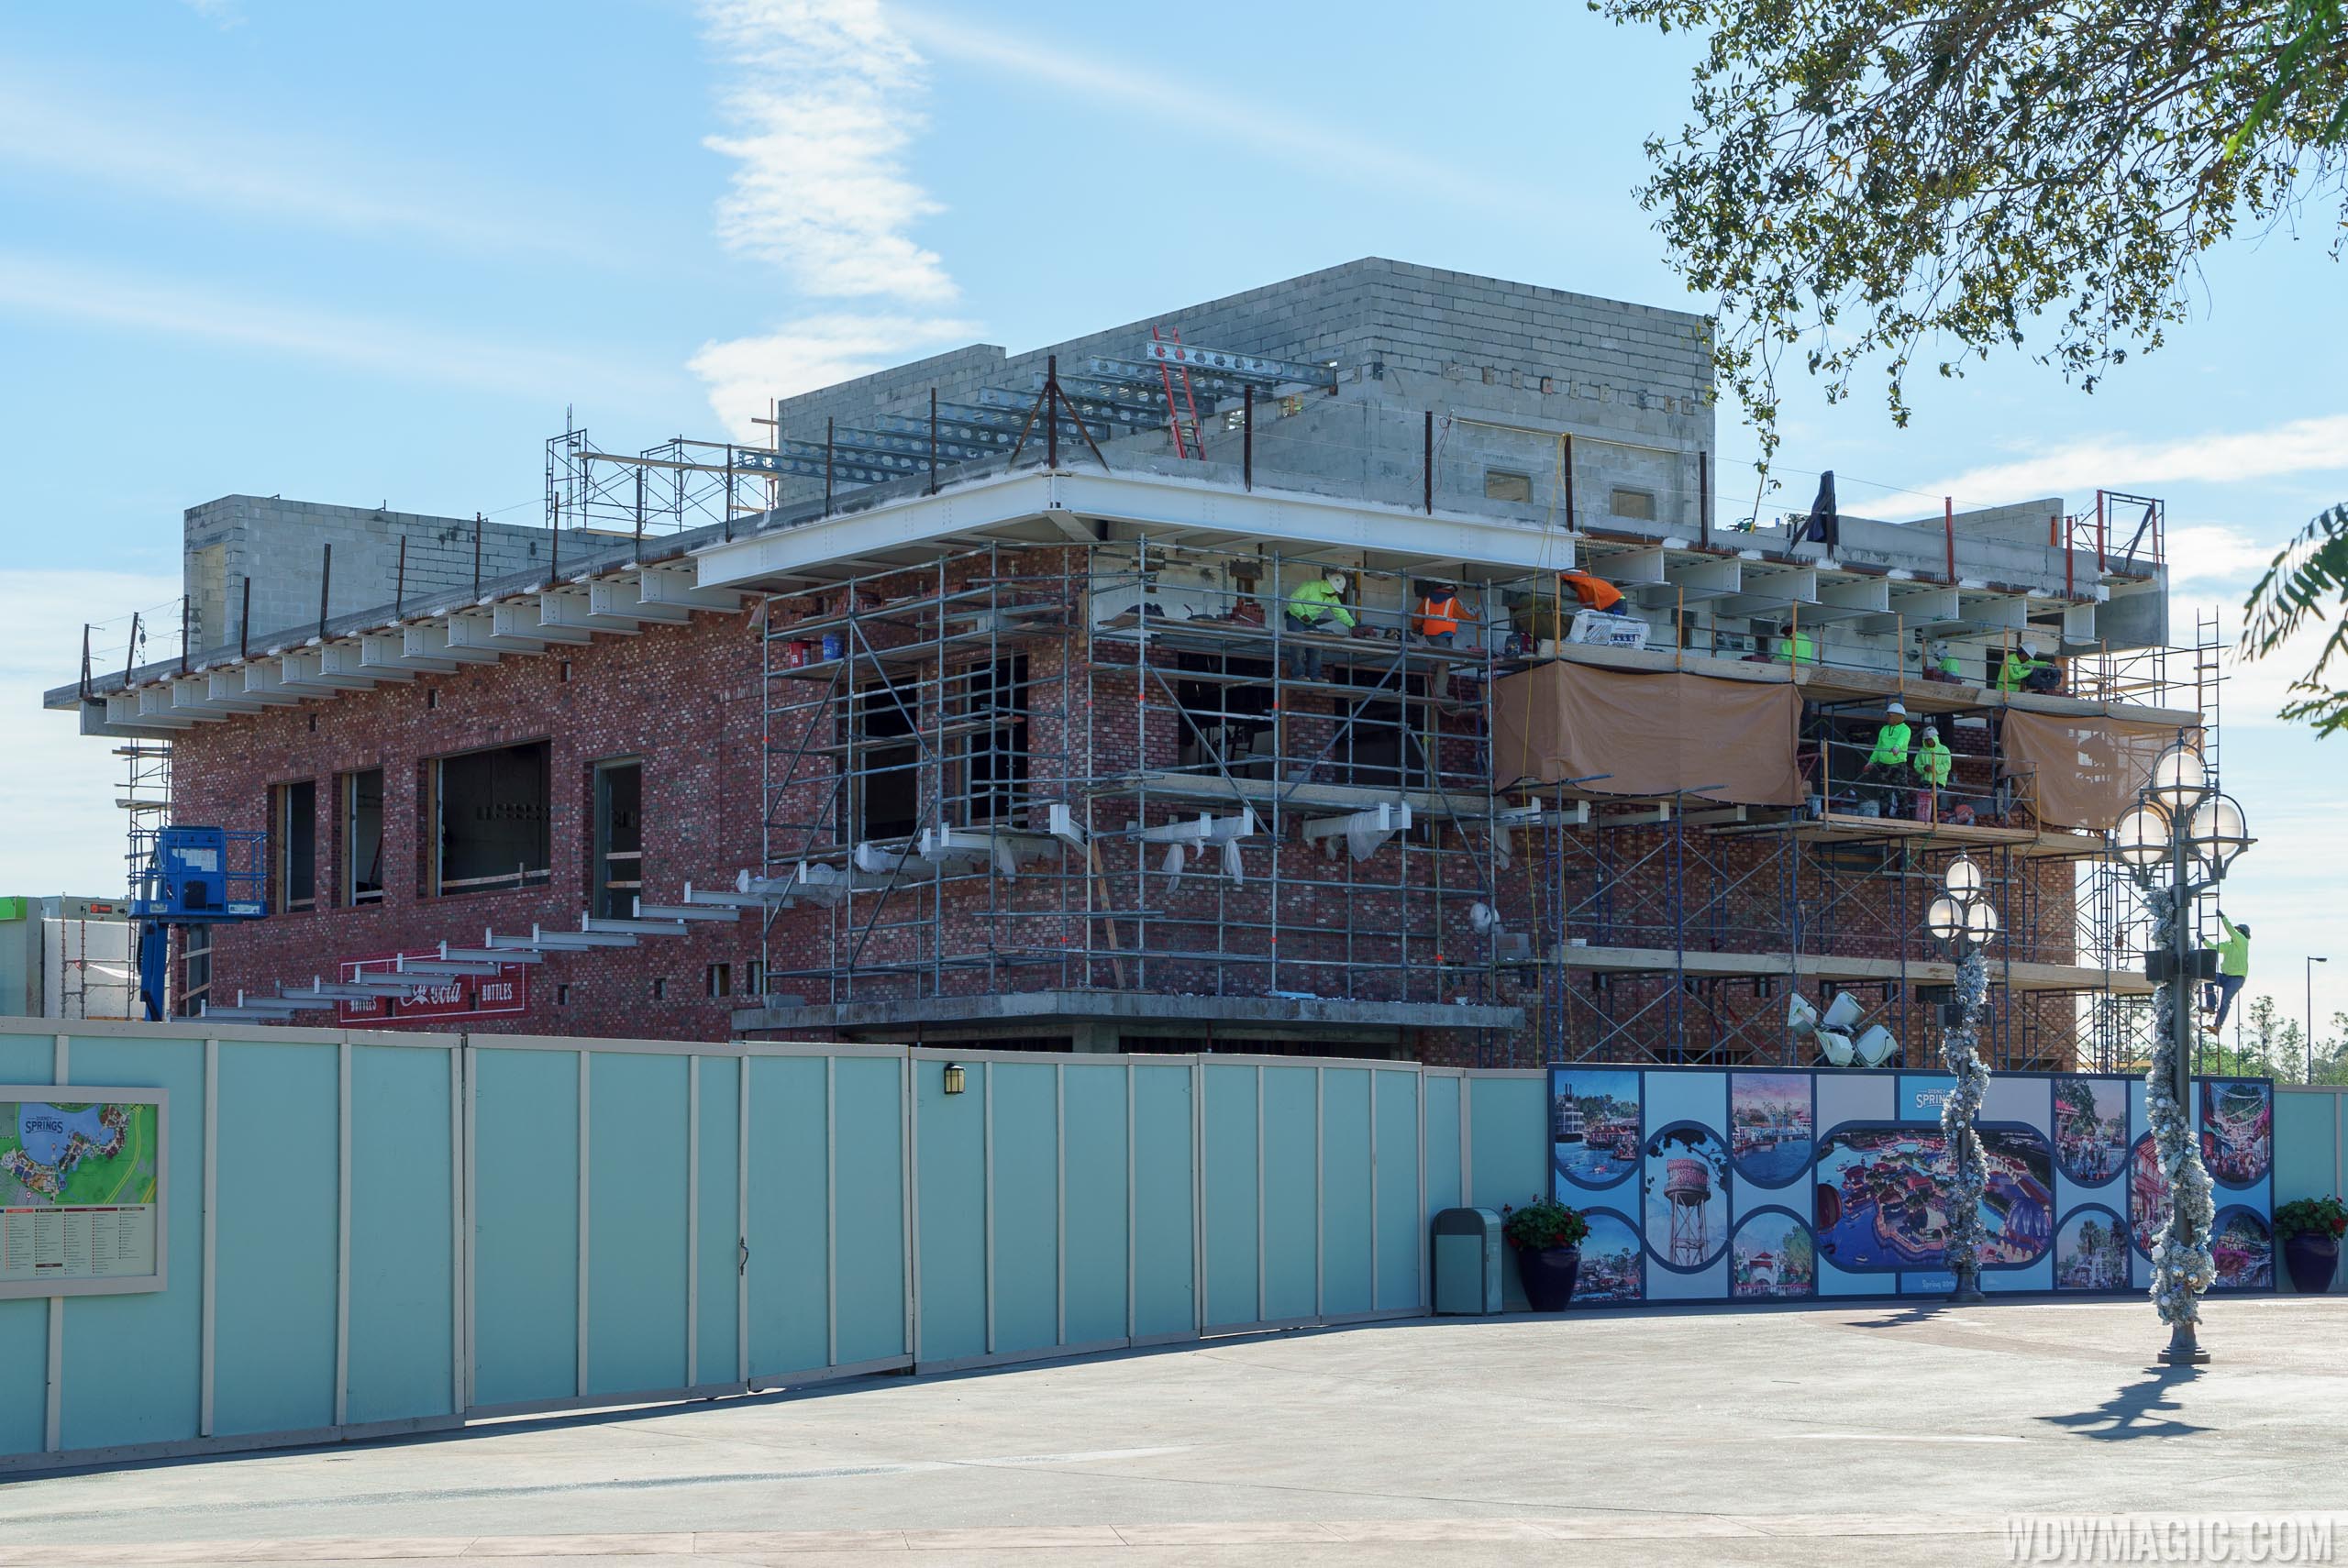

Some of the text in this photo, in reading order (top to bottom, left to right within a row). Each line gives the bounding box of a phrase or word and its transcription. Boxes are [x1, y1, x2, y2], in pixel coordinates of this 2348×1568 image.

[482, 983, 513, 1001] BOTTLES
[1916, 1094, 1952, 1109] SPRIN
[26, 1121, 63, 1133] SPRINGS
